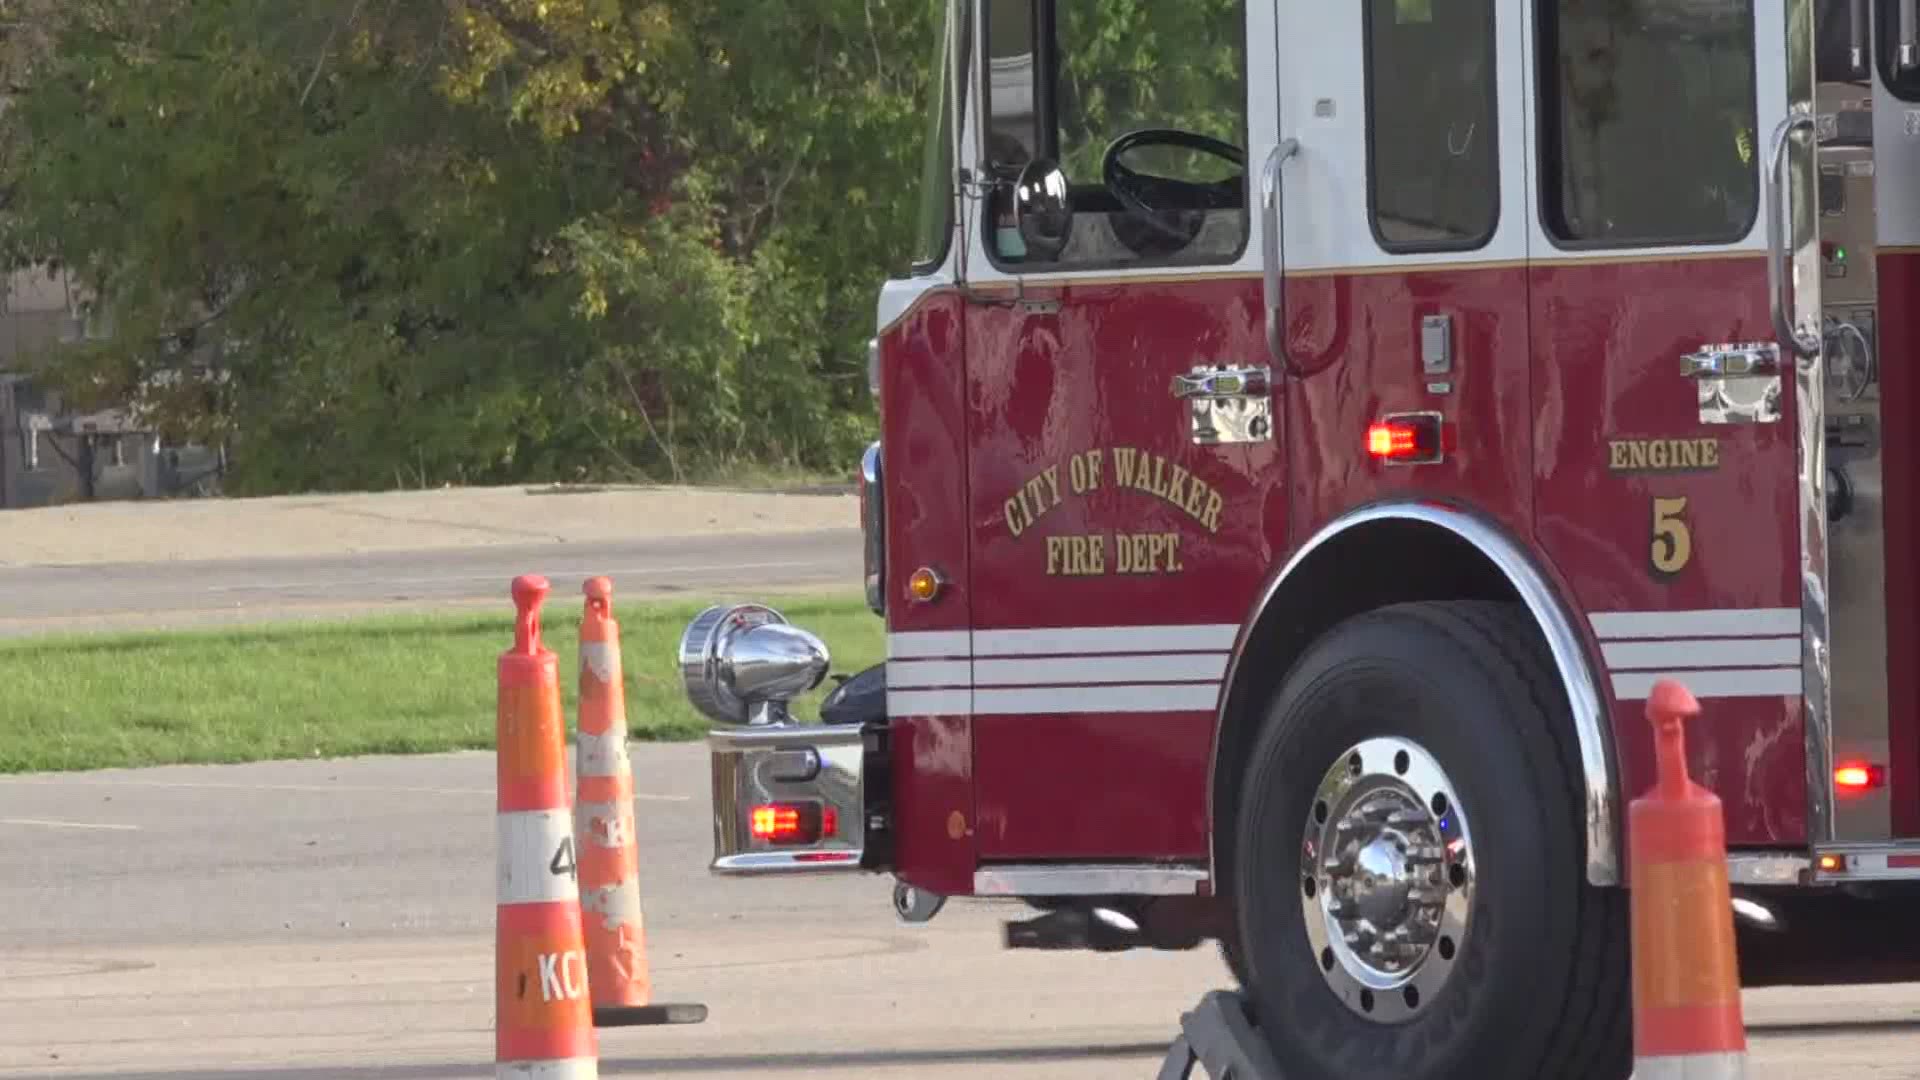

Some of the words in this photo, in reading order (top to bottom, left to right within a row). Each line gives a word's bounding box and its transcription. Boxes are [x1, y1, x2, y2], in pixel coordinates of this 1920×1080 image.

[1608, 438, 1719, 470] ENGINE
[1004, 465, 1062, 537] CITY
[1070, 449, 1102, 494] OF
[1113, 447, 1223, 533] WALKER
[1046, 535, 1104, 575] FIRE
[1115, 532, 1183, 573] DEPT.
[1651, 496, 1691, 573] 5
[549, 836, 577, 882] 4
[537, 950, 589, 1002] KC
